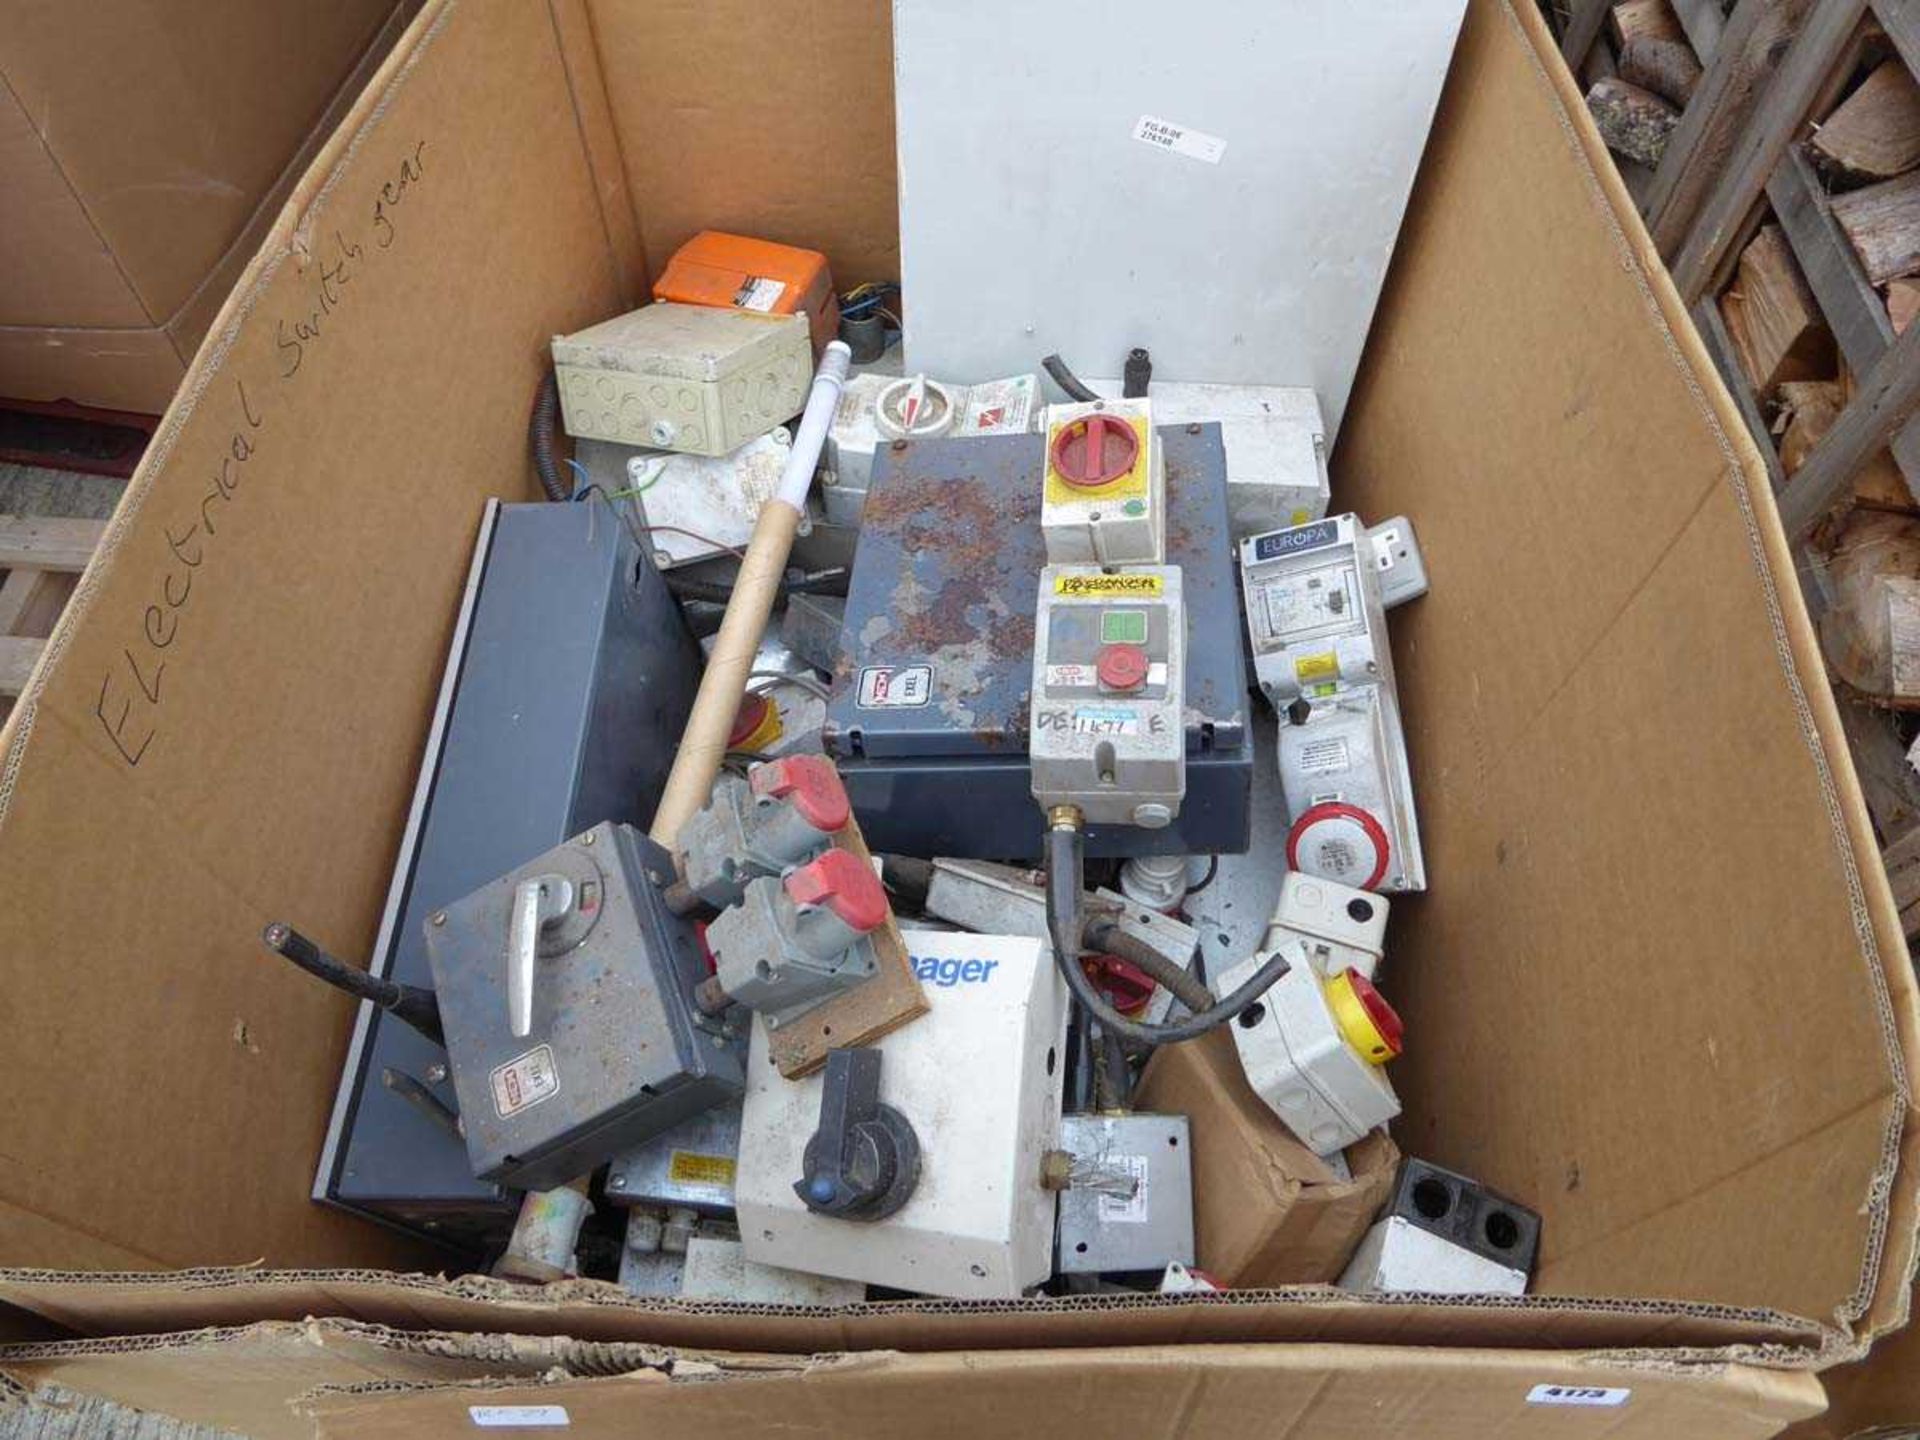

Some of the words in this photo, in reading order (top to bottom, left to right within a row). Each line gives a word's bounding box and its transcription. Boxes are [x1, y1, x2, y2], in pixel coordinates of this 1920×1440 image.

[374, 141, 425, 248] gear
[1263, 527, 1329, 553] EUROPA
[909, 957, 998, 987] ager
